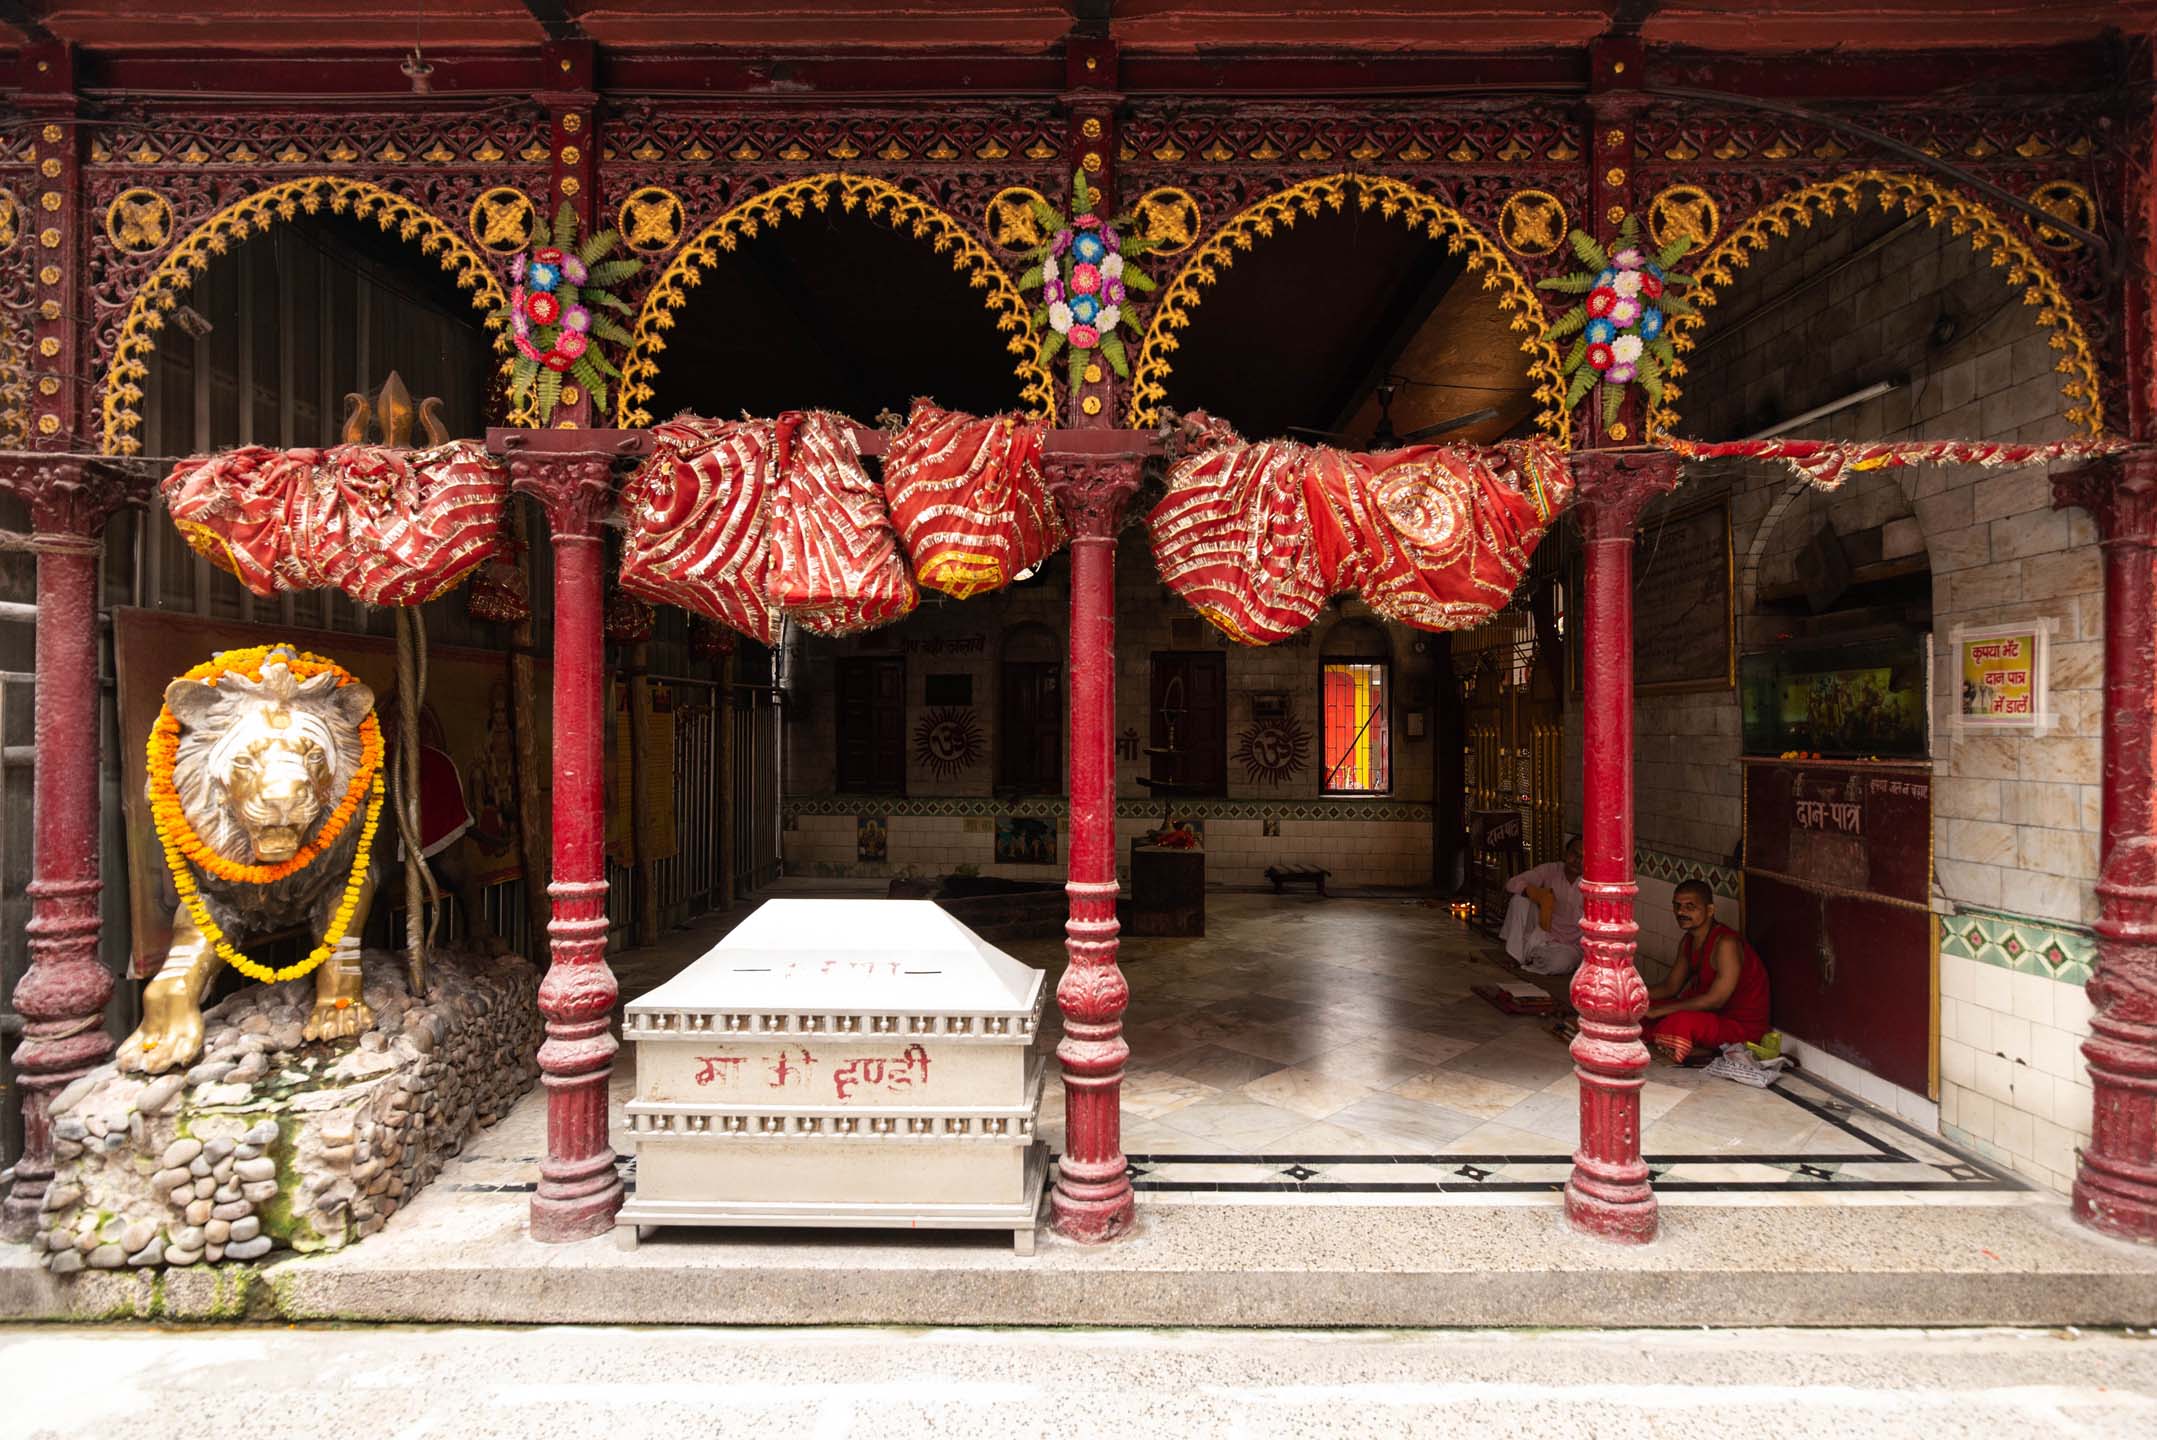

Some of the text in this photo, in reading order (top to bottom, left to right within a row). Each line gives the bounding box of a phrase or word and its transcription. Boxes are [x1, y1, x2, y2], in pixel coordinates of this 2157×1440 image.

[1972, 645, 2001, 665] कृपया
[1985, 672, 2026, 685] दान पात्र
[1993, 696, 2029, 714] में डालें
